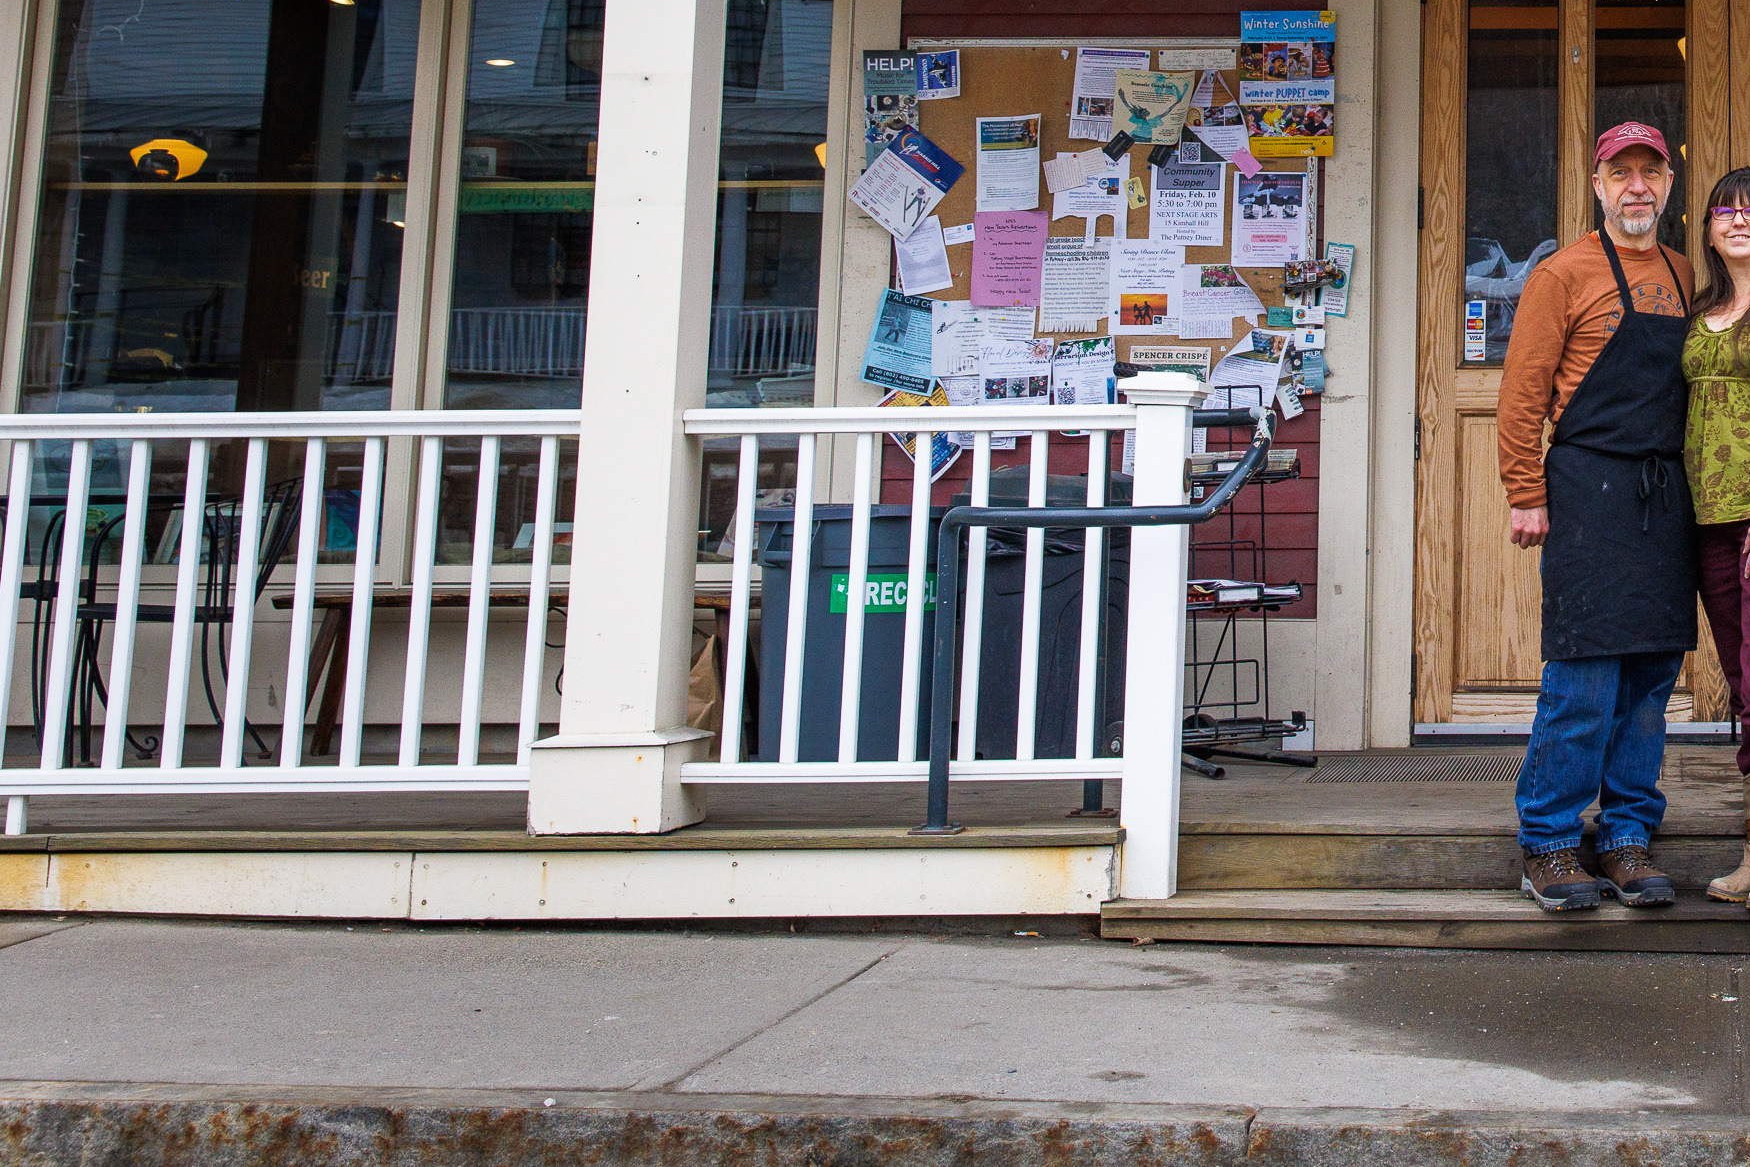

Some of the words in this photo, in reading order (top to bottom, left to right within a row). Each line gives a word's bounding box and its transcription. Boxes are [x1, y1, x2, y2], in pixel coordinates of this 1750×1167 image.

[1244, 19, 1279, 30] Winter
[1283, 19, 1330, 30] Sunshine
[867, 58, 914, 71] HELP!
[1244, 90, 1273, 98] winter
[1275, 88, 1306, 98] PUPPET
[1308, 89, 1330, 98] camp
[1164, 168, 1215, 177] Community
[1172, 179, 1205, 188] Supper
[1160, 191, 1186, 199] Friday,
[1182, 289, 1207, 297] Breast
[904, 296, 920, 304] CHI
[1089, 350, 1110, 358] Design
[1175, 352, 1208, 360] CRISPE
